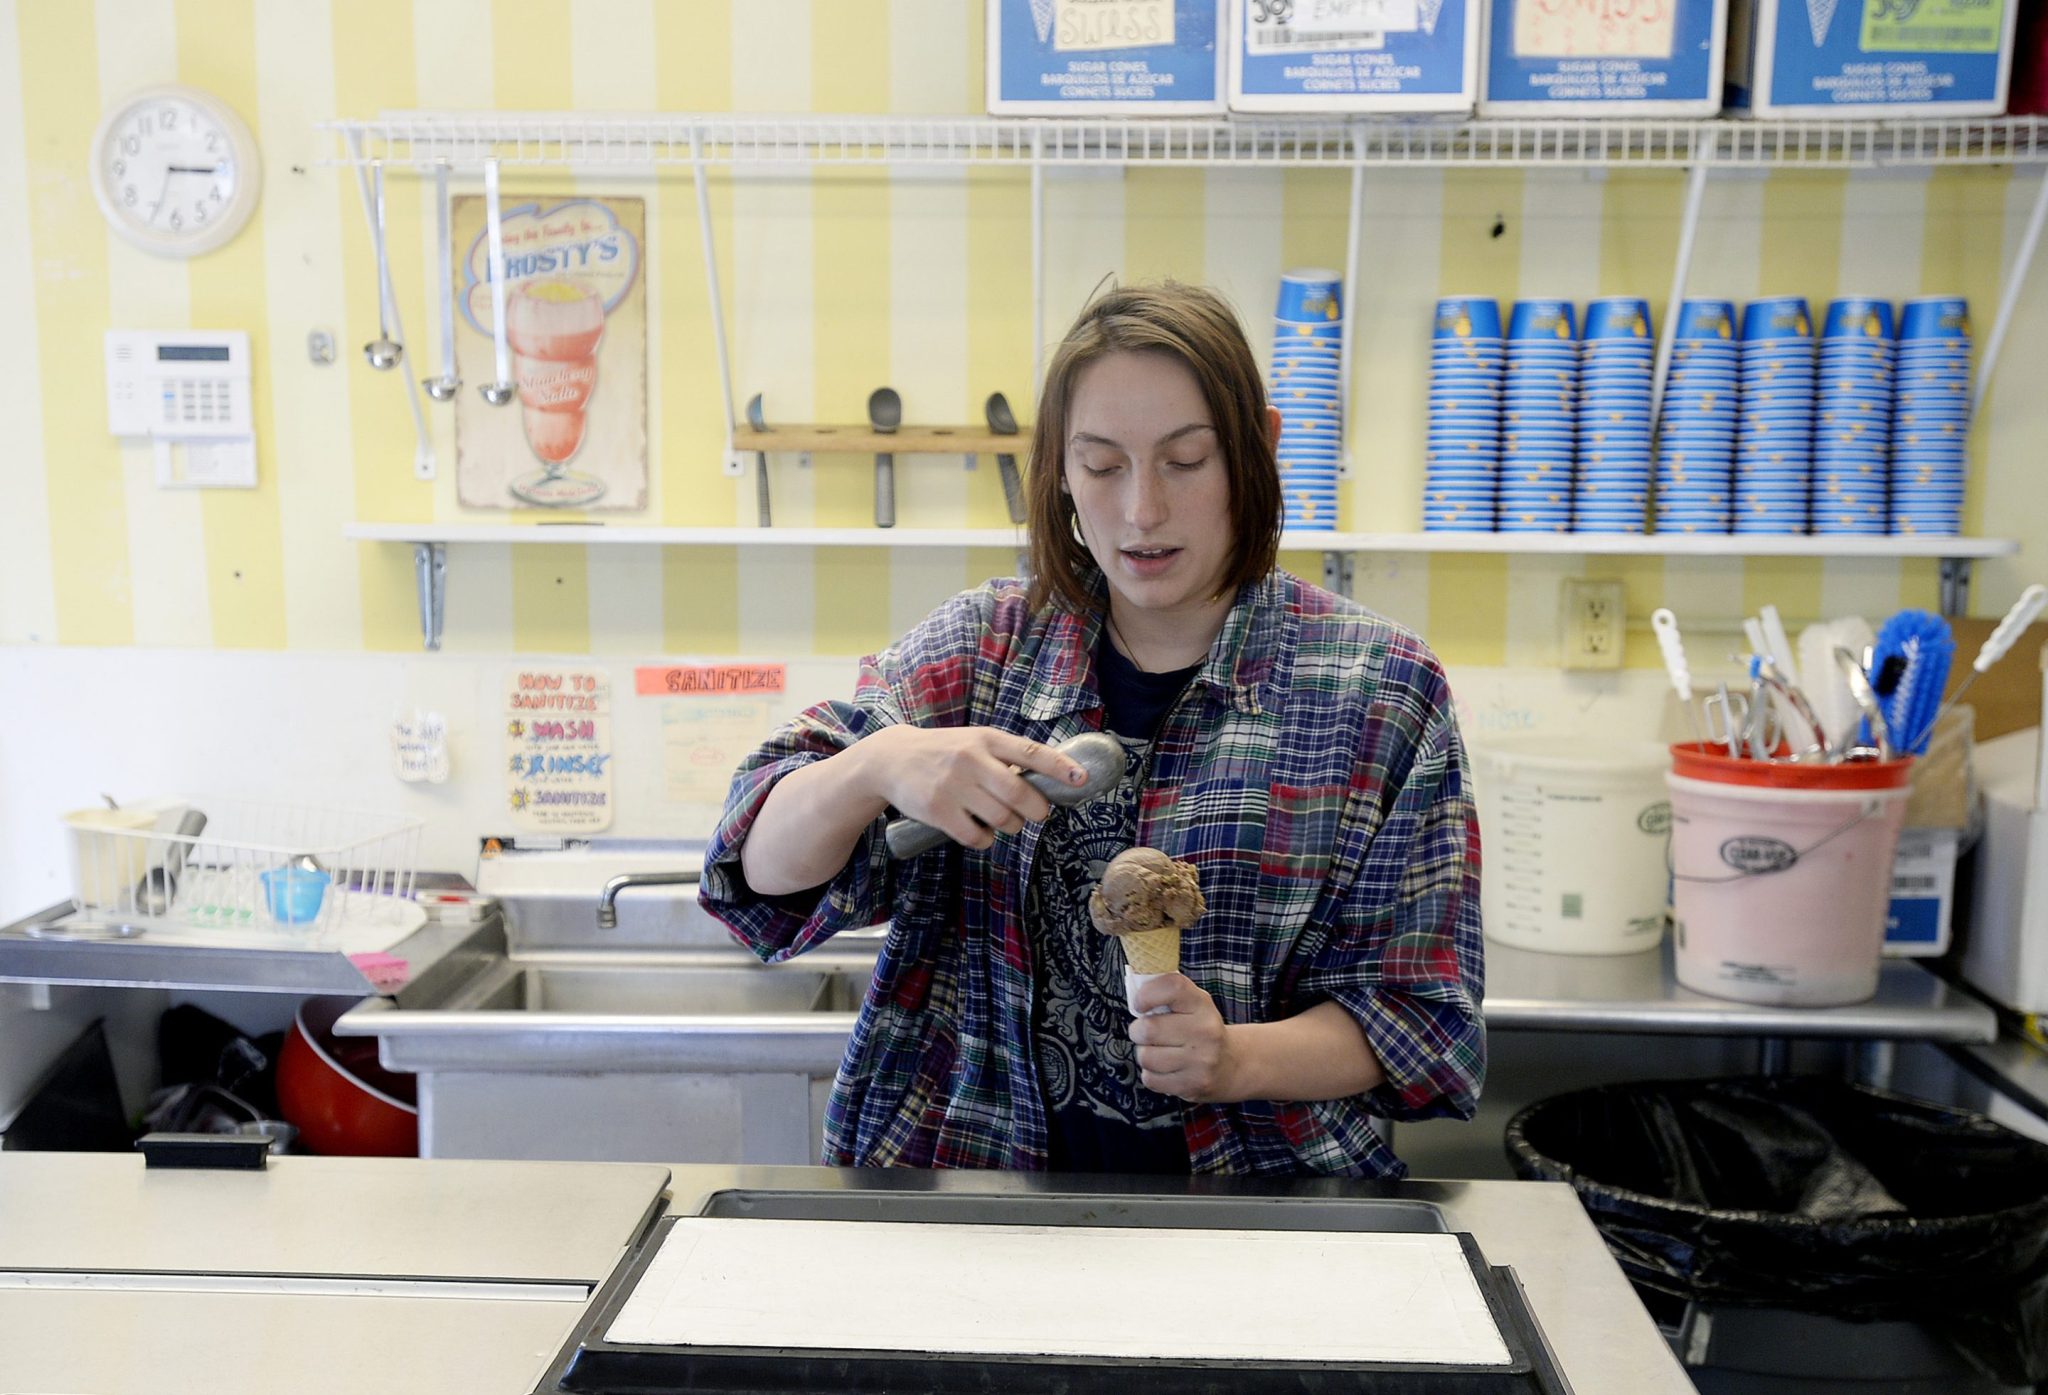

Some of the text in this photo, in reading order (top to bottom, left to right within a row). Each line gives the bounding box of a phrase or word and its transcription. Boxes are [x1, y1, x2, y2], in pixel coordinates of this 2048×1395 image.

[1067, 61, 1148, 73] SUGAR CONES
[1312, 54, 1395, 65] SUGAR CONES
[138, 117, 153, 137] 11
[160, 109, 177, 131] 12
[120, 134, 141, 157] 10
[205, 131, 218, 153] 2
[112, 159, 126, 178] 9
[124, 184, 137, 208] 8
[209, 185, 221, 203] 4
[170, 209, 183, 231] 6
[194, 201, 207, 224] 5
[518, 673, 596, 692] HOW TO
[665, 668, 782, 692] SANITIZE
[511, 692, 598, 711] SANITIZE
[532, 720, 594, 741] WASH
[527, 753, 606, 777] RINSE
